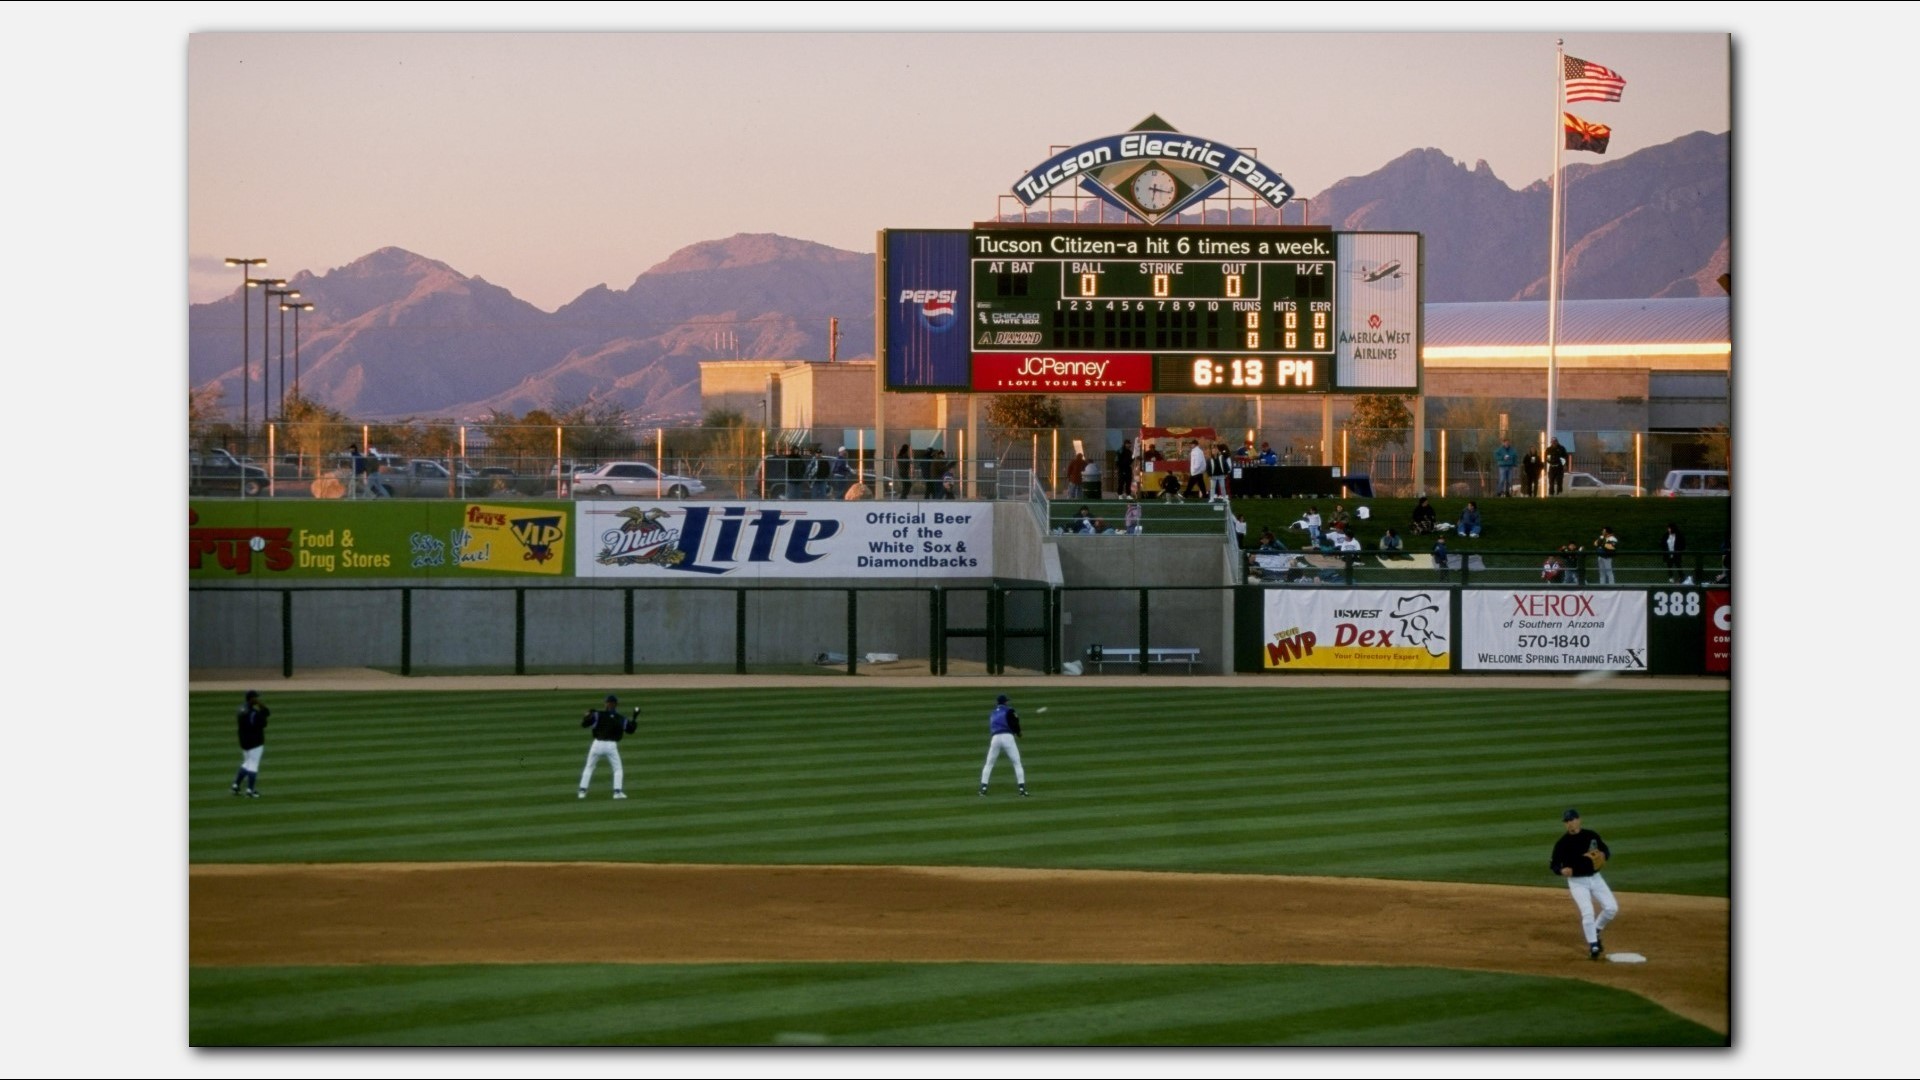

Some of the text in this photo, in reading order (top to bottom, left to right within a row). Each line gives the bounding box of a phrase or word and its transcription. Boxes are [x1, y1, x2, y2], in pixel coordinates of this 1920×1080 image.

[1017, 135, 1289, 205] Tucson Electric Park
[976, 236, 1042, 253] Tucson
[1146, 237, 1170, 254] hit
[1177, 237, 1190, 254] 6
[1198, 238, 1250, 254] times
[1258, 242, 1269, 254] a
[1276, 238, 1330, 254] week.
[989, 262, 1034, 274] AT BAT
[1072, 262, 1105, 274] BALL
[1140, 263, 1184, 275] STRIKE
[1222, 264, 1247, 275] OUT
[1296, 264, 1323, 275] H/E
[1081, 274, 1096, 296] 0
[1154, 274, 1168, 296] 0
[1226, 275, 1240, 297] 0
[900, 290, 957, 303] PEPSI
[1056, 301, 1062, 311] 1
[1070, 301, 1077, 311] 2
[1086, 301, 1093, 311] 3
[1106, 301, 1114, 311] 4
[1122, 301, 1129, 311] 5
[1137, 301, 1144, 311] 6
[1158, 302, 1165, 311] 7
[1173, 302, 1180, 311] 8
[1188, 302, 1195, 311] 9
[1208, 302, 1218, 311] 10
[1233, 302, 1261, 311] RUNS
[1274, 302, 1296, 311] HITS
[1310, 302, 1331, 312] ERR
[1247, 312, 1259, 328] 0
[1285, 312, 1296, 328] 0
[1314, 312, 1325, 328] 0
[994, 332, 1042, 344] DIAMOND
[1247, 332, 1259, 348] 0
[1285, 332, 1296, 348] 0
[1314, 332, 1325, 348] 0
[1340, 330, 1410, 344] AMERICA WEST
[1354, 346, 1397, 360] AIRLINES
[1018, 358, 1108, 379] JCPenney
[1194, 359, 1313, 386] 6:13 PM
[866, 512, 972, 524] Official Beer
[300, 530, 353, 547] Food &
[892, 527, 943, 538] of the
[411, 532, 445, 553] Sign
[601, 528, 679, 557] Miller
[664, 507, 840, 574] Lite
[869, 541, 966, 553] White Sox &
[300, 550, 390, 572] Drug Stores
[411, 550, 445, 568] and
[857, 556, 978, 568] Diamondbacks
[1513, 594, 1595, 617] XEROX
[1654, 591, 1700, 616] 388
[1503, 620, 1604, 628] of Southern Arizona
[1334, 623, 1394, 648] Dex
[1518, 635, 1590, 648] 570-1840
[1267, 631, 1316, 666] MVP
[1393, 653, 1419, 661] Expert
[1478, 653, 1631, 664] WELCOME SPRING TRAINING FANS
